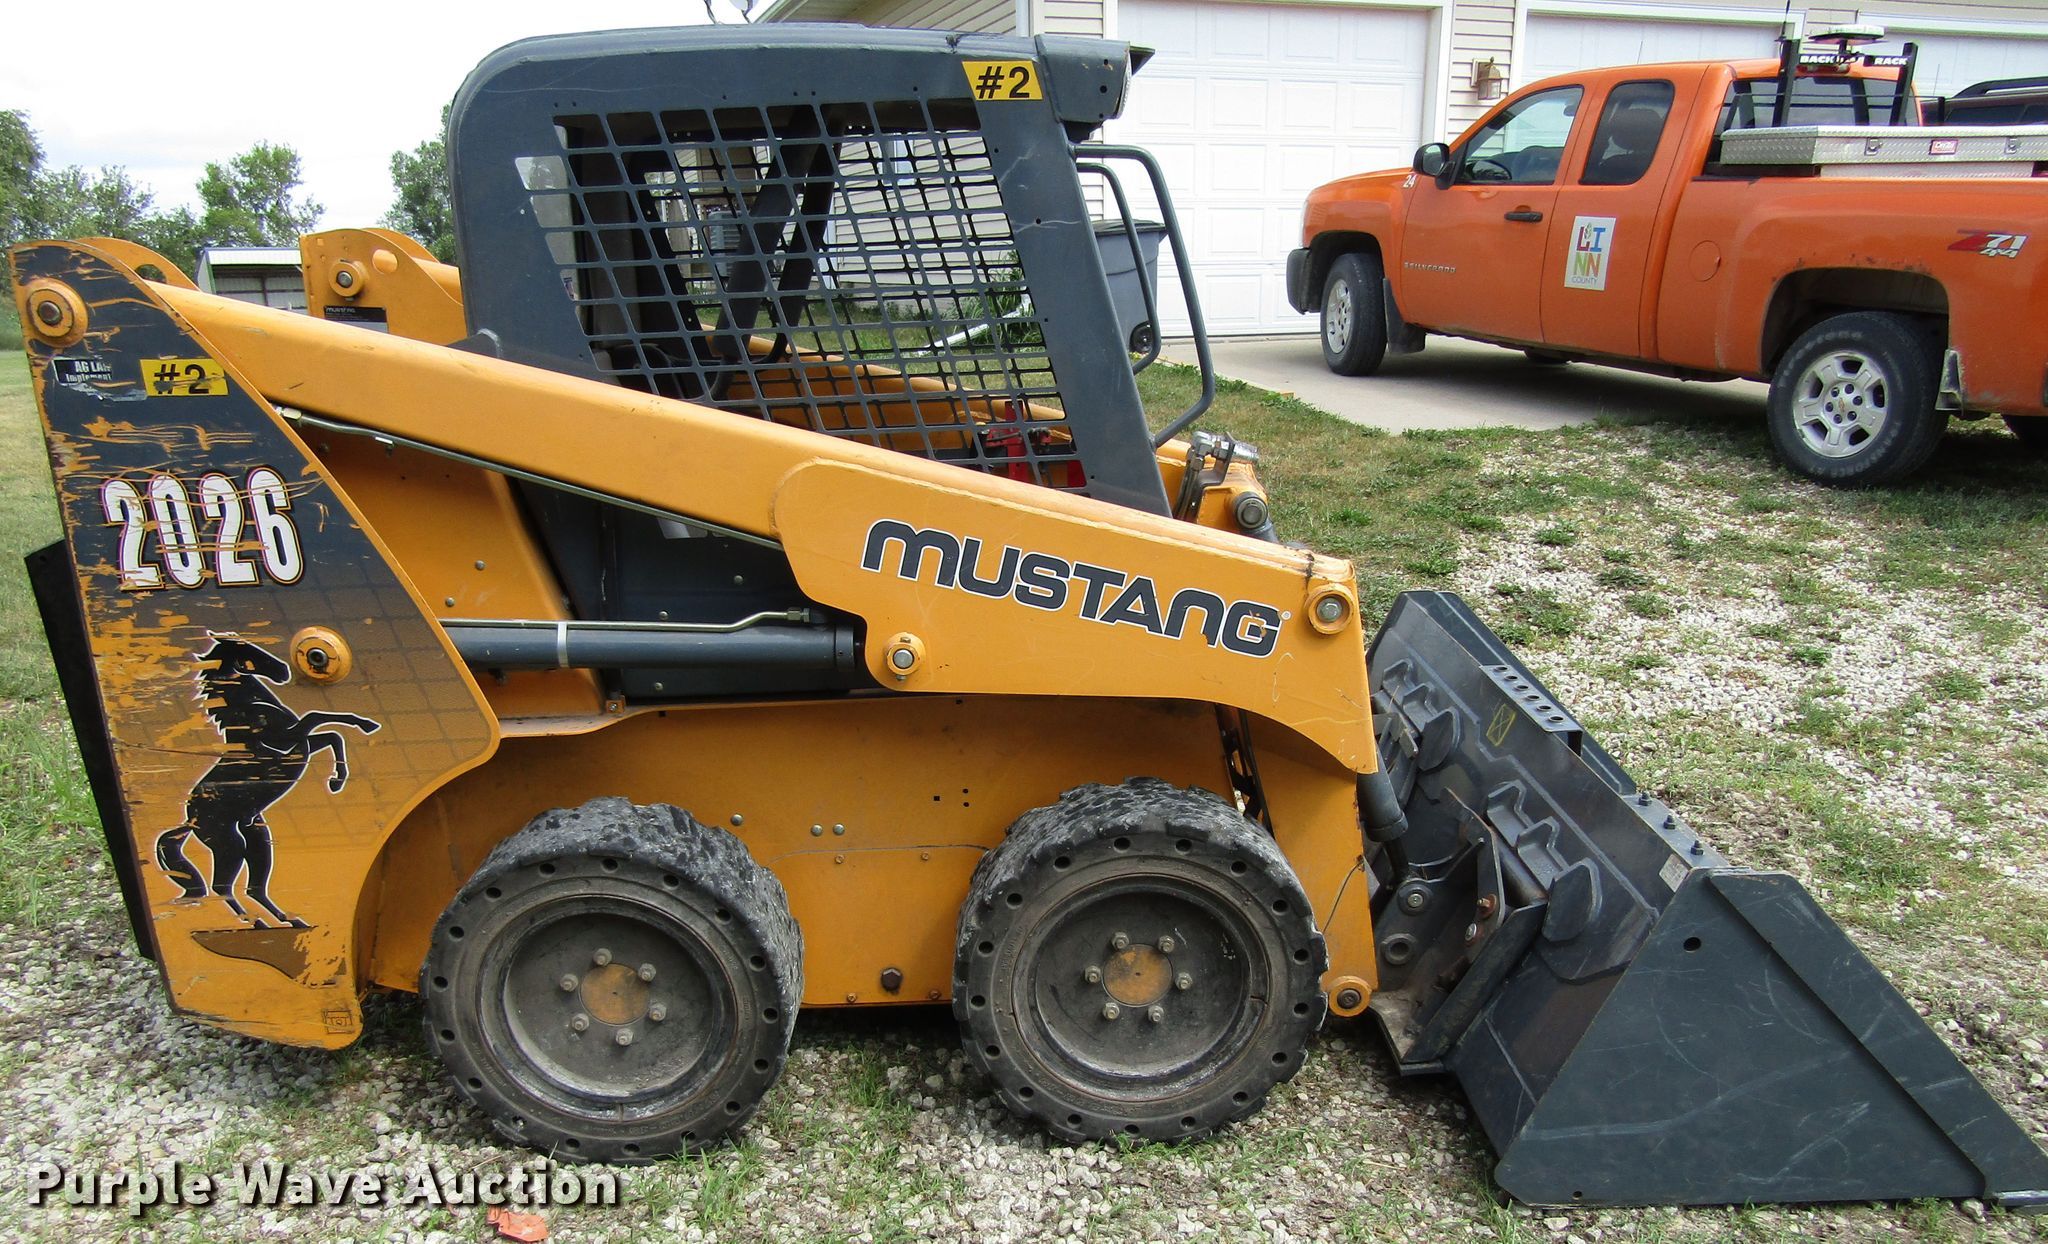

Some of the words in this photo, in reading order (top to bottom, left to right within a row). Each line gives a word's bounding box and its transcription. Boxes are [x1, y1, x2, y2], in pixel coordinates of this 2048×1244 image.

[1800, 55, 1834, 64] BACK
[1874, 57, 1908, 66] RACK
[976, 65, 1031, 99] #2
[1403, 174, 1417, 188] 24
[1572, 276, 1599, 285] COUNTY
[153, 364, 210, 394] #2
[102, 468, 304, 590] 2026
[861, 519, 1282, 658] MUSTANG
